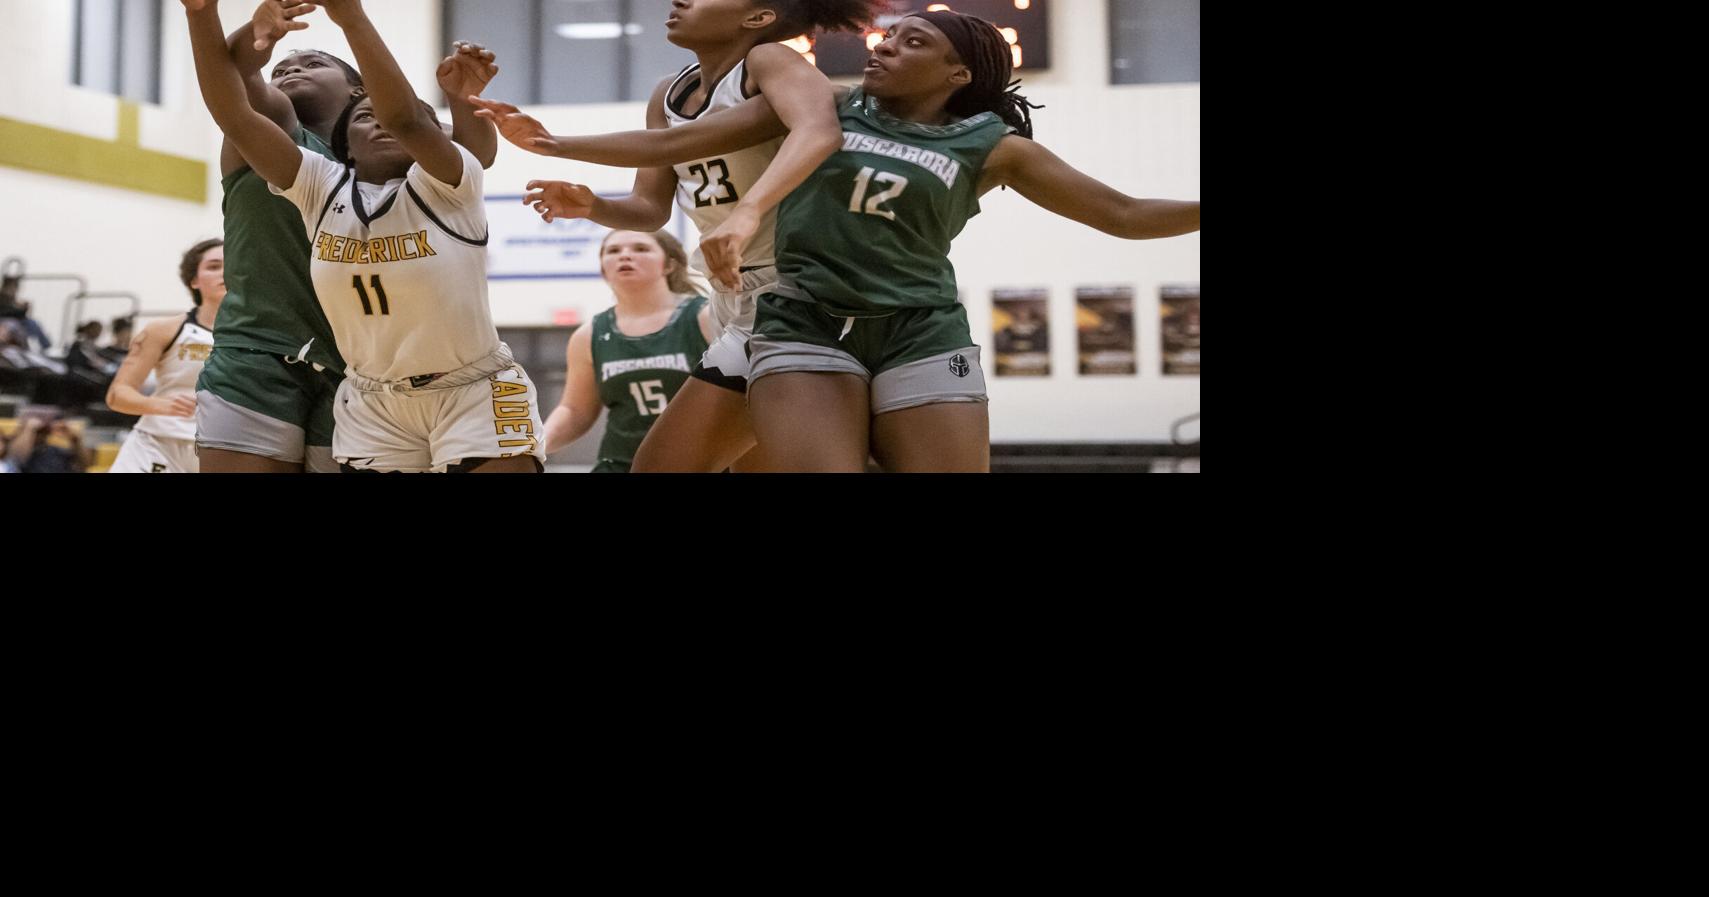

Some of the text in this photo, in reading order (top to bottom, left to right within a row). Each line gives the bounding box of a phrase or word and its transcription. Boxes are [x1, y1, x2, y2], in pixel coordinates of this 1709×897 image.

[688, 158, 739, 208] 23
[842, 131, 960, 190] USCARORA
[848, 166, 909, 221] 12
[352, 274, 390, 315] 11
[629, 380, 668, 416] 15
